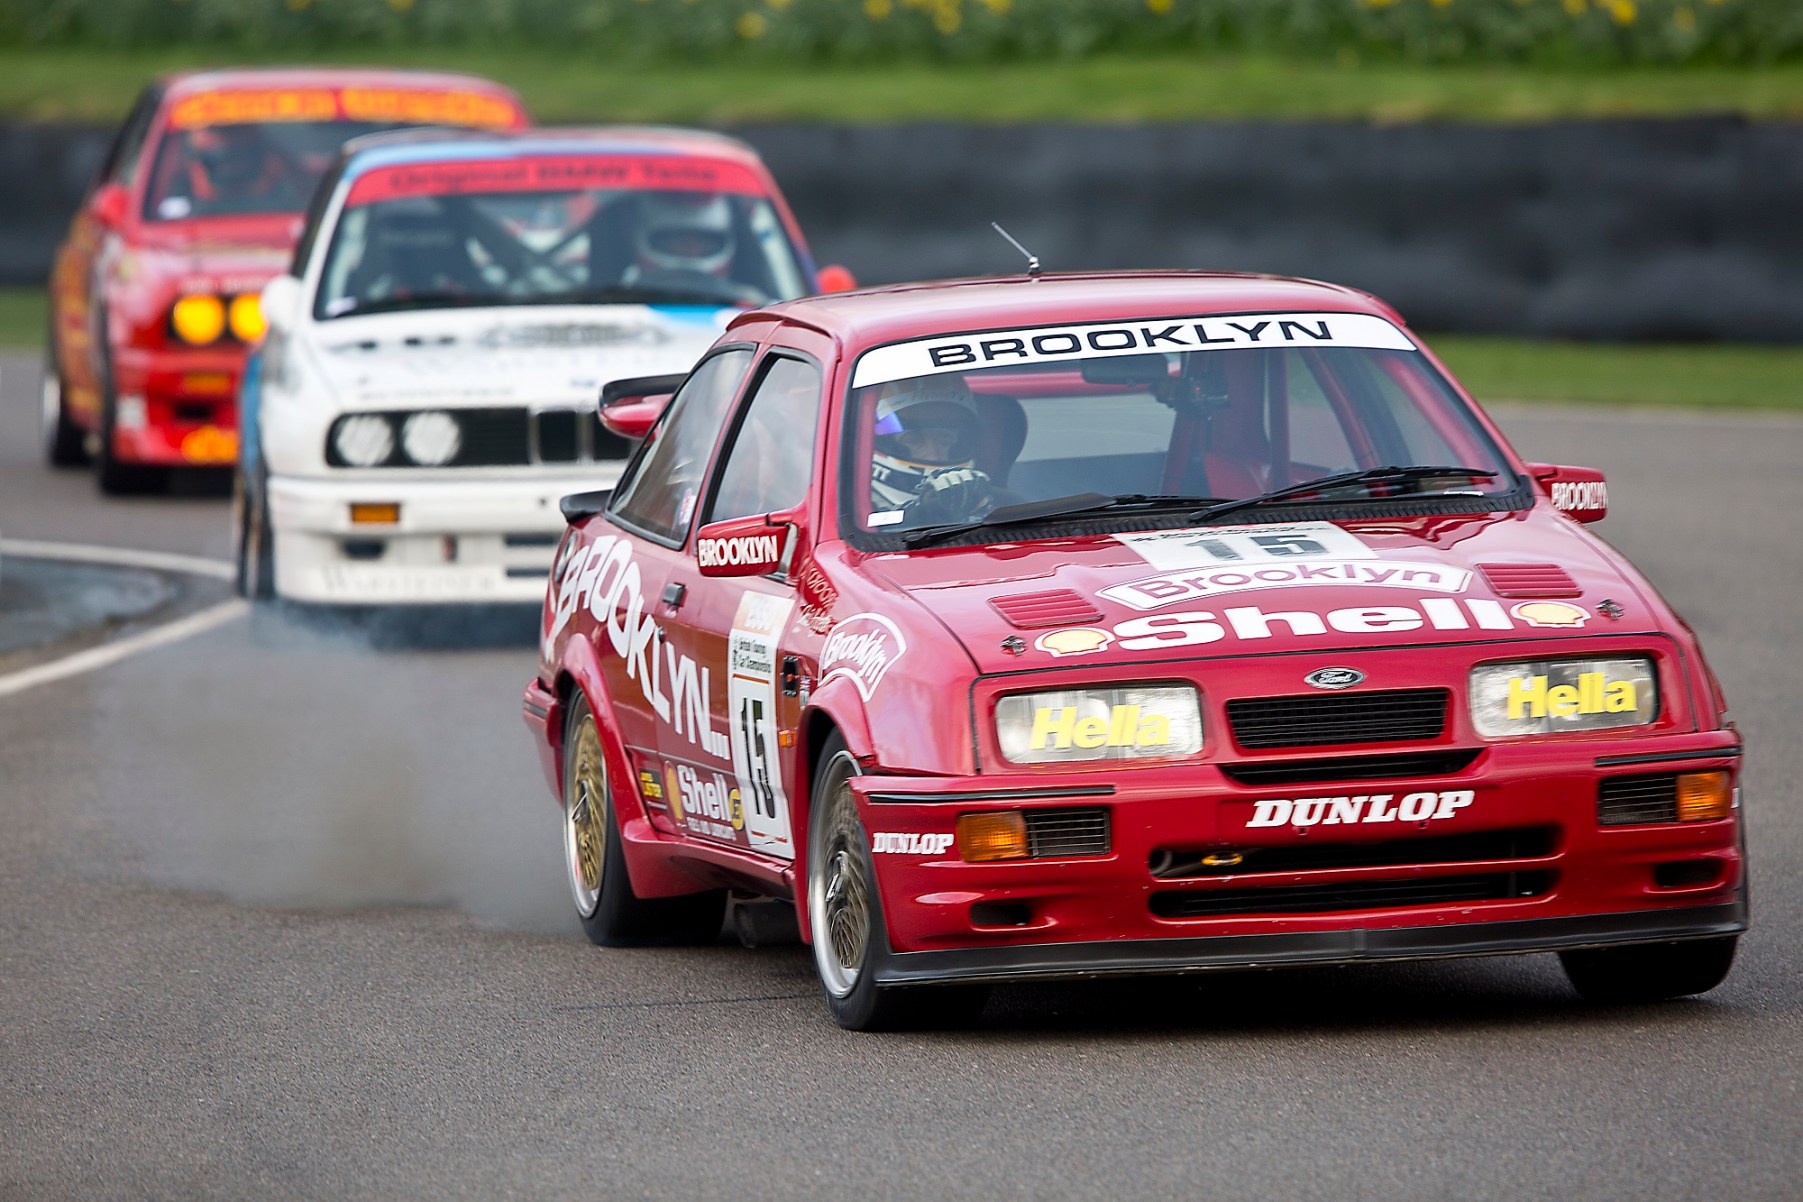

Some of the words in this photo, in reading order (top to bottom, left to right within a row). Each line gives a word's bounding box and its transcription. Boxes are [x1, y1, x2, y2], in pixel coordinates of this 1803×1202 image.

[928, 320, 1333, 368] BROOKLYN
[1551, 482, 1608, 510] BROOKLYN
[698, 535, 778, 567] BROOKLYN
[1184, 534, 1330, 561] 15
[1128, 563, 1441, 600] Brooklyn
[1113, 597, 1514, 651] Shell
[823, 629, 887, 684] Brooklyn
[1507, 672, 1638, 719] Hella
[1030, 704, 1170, 750] Hella
[741, 697, 775, 819] 15
[677, 764, 732, 822] Shell
[1245, 790, 1475, 828] DUNLOP
[872, 832, 954, 855] DUNLOP
